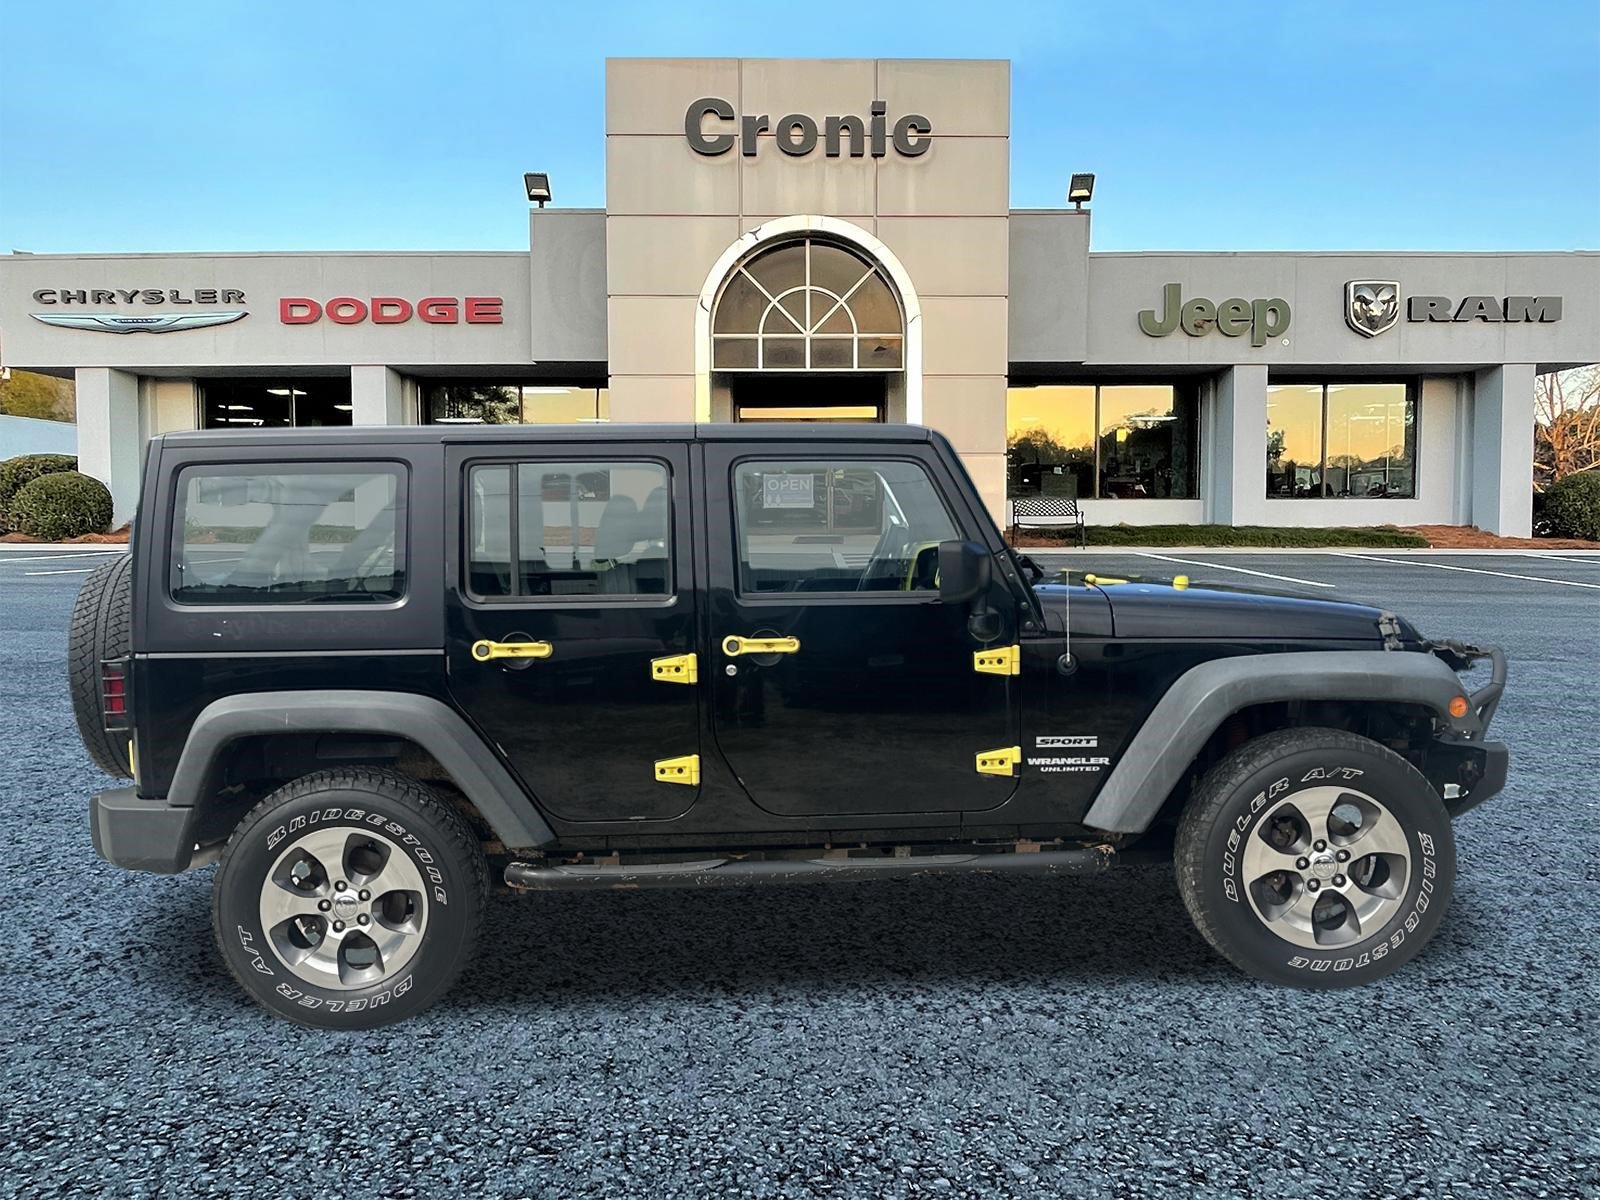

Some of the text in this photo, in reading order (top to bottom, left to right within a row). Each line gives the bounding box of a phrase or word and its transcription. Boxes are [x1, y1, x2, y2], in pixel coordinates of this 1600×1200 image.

[685, 97, 932, 158] Cronic
[33, 288, 245, 305] CHRYSLER
[279, 297, 504, 325] DODGE
[1138, 283, 1290, 347] Jeep
[1407, 296, 1562, 323] RAM
[767, 479, 810, 491] OPEN
[1027, 757, 1110, 765] WRANGLER
[267, 808, 448, 905] BRIDGESTONE
[1223, 767, 1365, 903] DUELER A/T
[1287, 831, 1437, 972] BRIDGESTONE
[237, 925, 414, 1013] DUELER A/T
